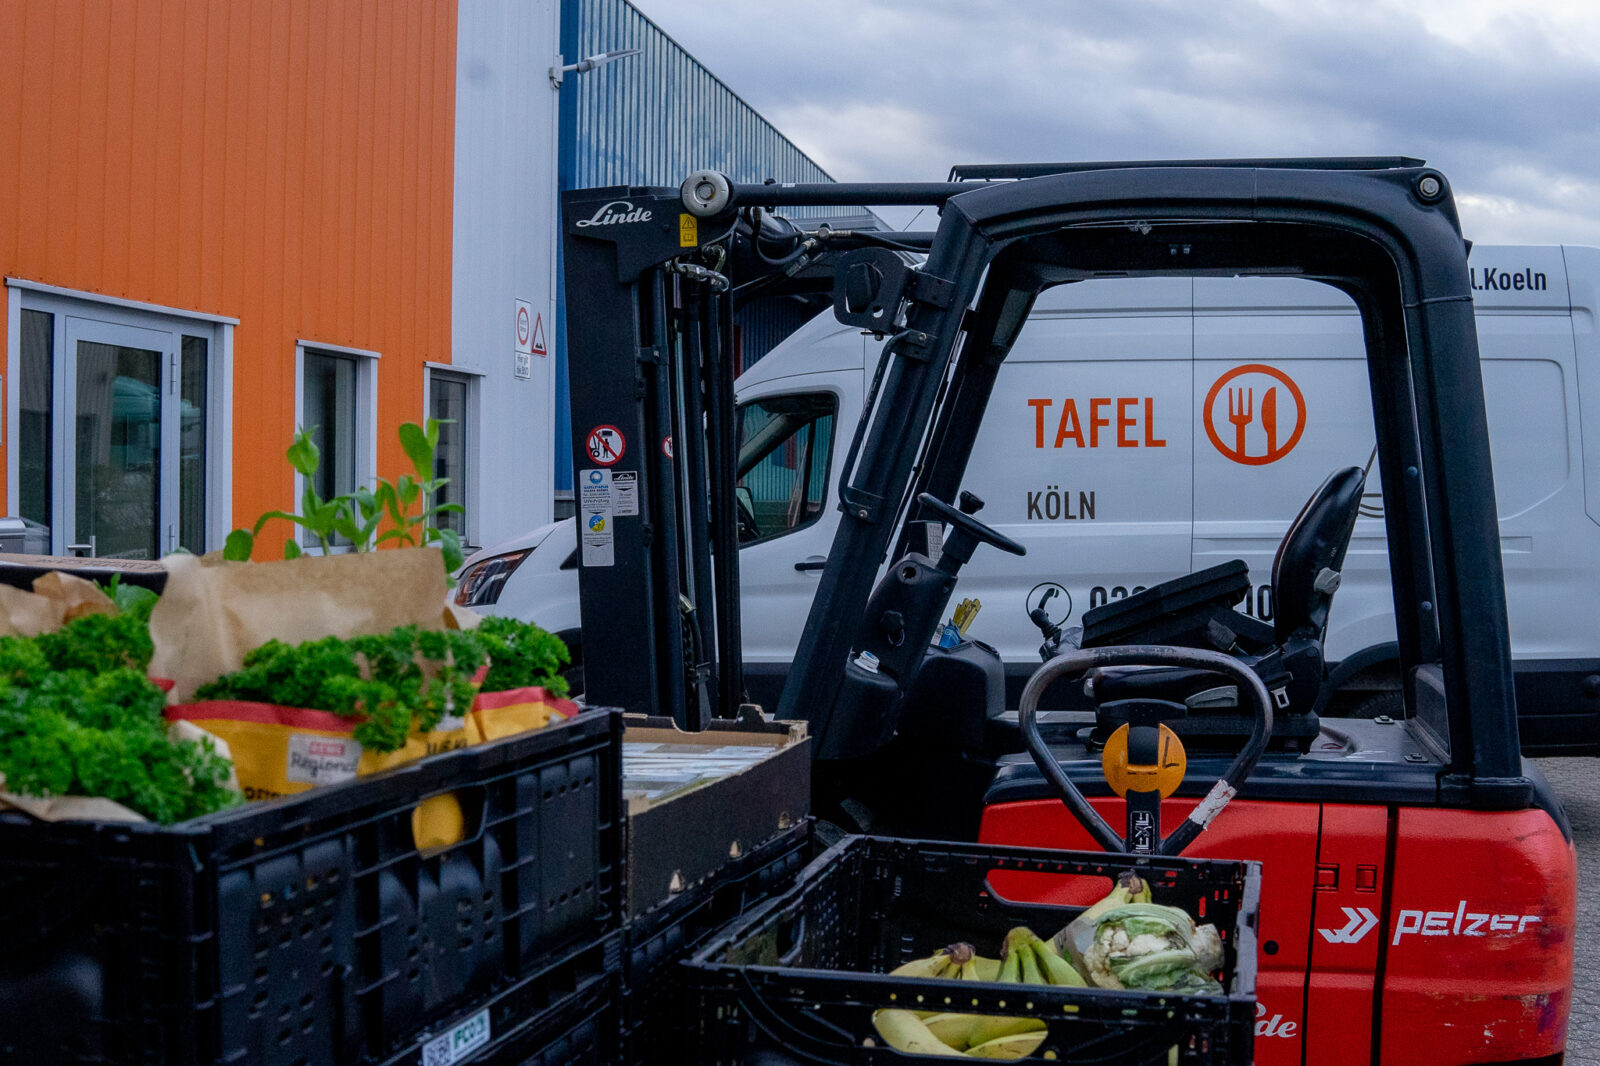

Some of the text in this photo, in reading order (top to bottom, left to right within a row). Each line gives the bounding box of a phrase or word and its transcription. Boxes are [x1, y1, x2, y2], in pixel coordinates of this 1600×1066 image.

[576, 201, 652, 227] Linde
[1027, 397, 1166, 448] TAFEL
[1027, 485, 1096, 520] KÖLN
[1254, 1002, 1297, 1038] de
